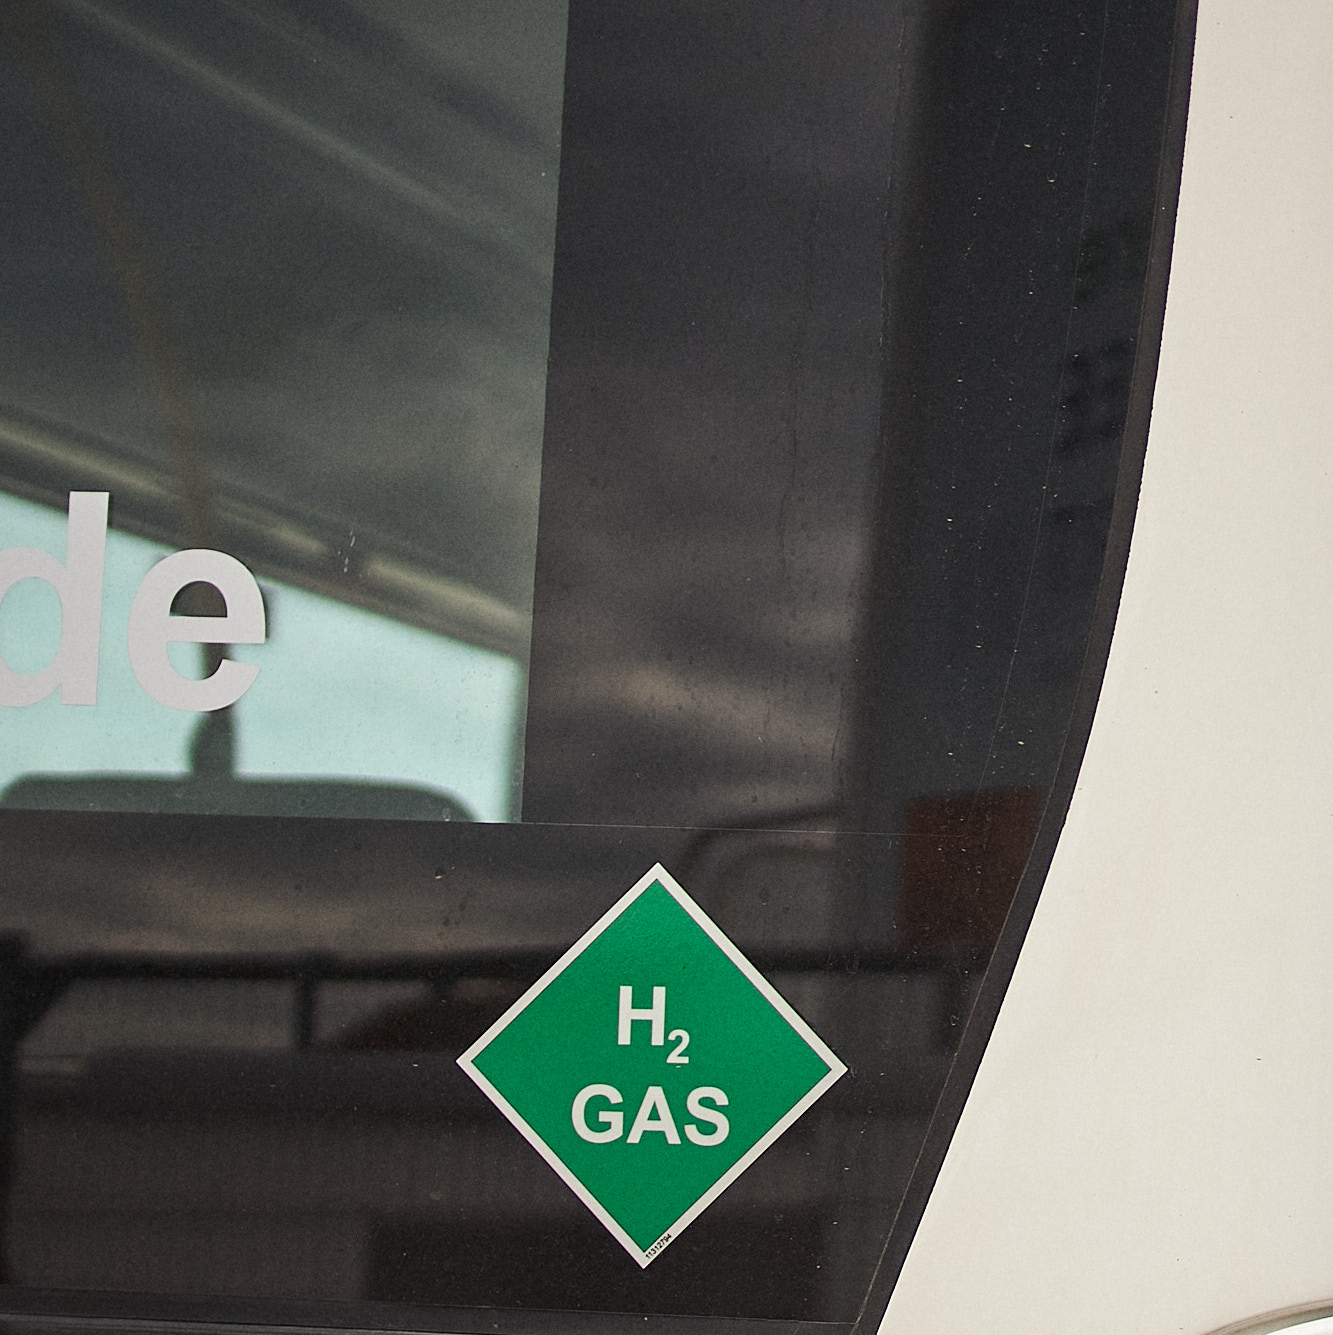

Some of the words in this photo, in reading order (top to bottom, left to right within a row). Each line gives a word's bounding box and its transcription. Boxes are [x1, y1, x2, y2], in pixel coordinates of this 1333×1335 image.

[0, 490, 267, 713] de
[570, 1083, 731, 1147] GAS
[645, 1233, 672, 1259] 11312794
